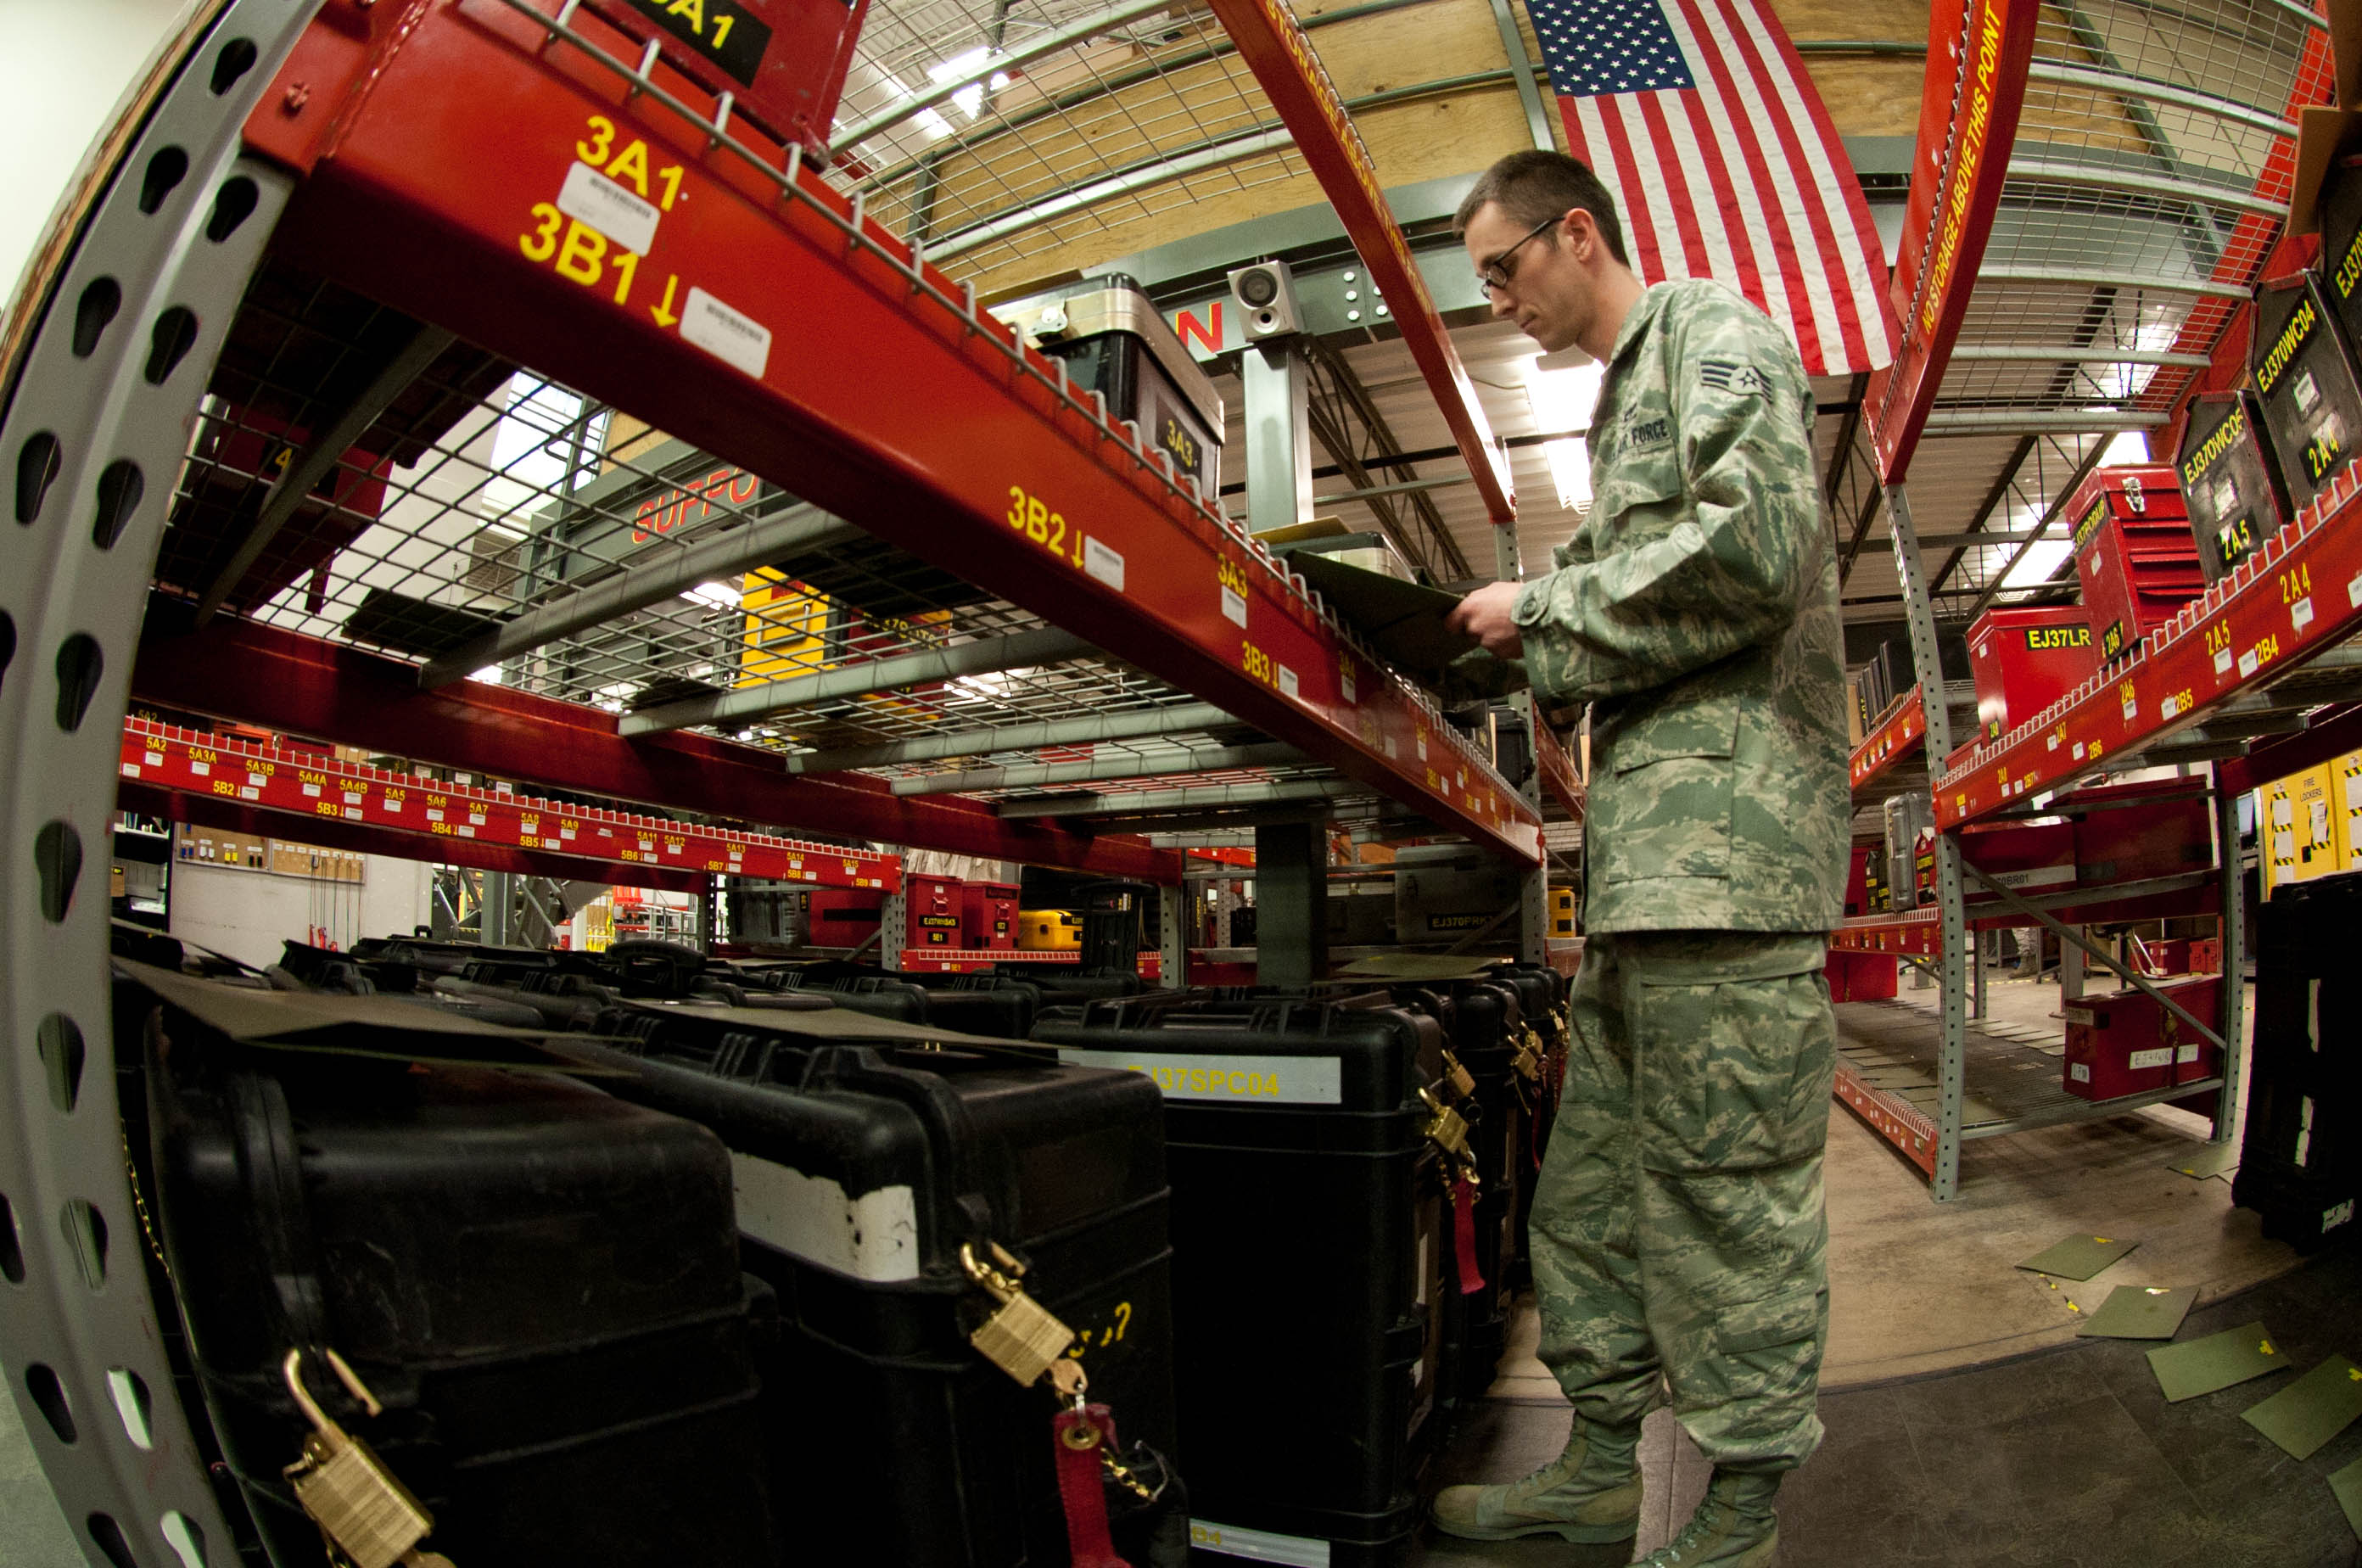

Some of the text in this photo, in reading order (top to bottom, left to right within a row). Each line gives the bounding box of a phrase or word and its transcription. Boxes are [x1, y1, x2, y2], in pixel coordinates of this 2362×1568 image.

[652, 0, 735, 49] A1
[577, 115, 684, 210] 3A1
[1922, 0, 2001, 334] NO STORAGE ABOVE THIS POINT
[520, 203, 639, 305] 3B1
[2258, 300, 2314, 391] EJ370WC04
[1632, 418, 1668, 448] FORCE
[1167, 421, 1193, 467] 3A3
[2309, 433, 2339, 478] 2A4
[1008, 485, 1066, 557] 3B2
[2222, 520, 2249, 560] 2A5
[1217, 553, 1248, 597] 3A3
[2279, 563, 2311, 605] 2A4
[2028, 628, 2091, 648] EJ37LR
[2205, 619, 2230, 657] 2A5
[2254, 633, 2279, 666] 2B4
[1242, 641, 1269, 683] 3B3
[2119, 678, 2135, 705] 2A6
[2174, 687, 2193, 714] 2B5
[2055, 721, 2067, 743] 2A7
[146, 736, 167, 752] 5A2
[2087, 739, 2102, 760] 2B6
[189, 746, 217, 764] 5A3A
[245, 759, 275, 776] 5A3B
[213, 780, 235, 797] 5B2
[299, 770, 327, 787] 5A4A
[339, 778, 368, 795] 5A4B
[385, 787, 406, 802] 5A5
[427, 793, 447, 808] 5A6
[316, 801, 338, 816] 5B3
[469, 801, 490, 815] 5A7
[432, 821, 452, 836] 5B4
[521, 812, 540, 827] 5A8
[561, 818, 579, 832] 5A9
[520, 835, 539, 848] 5B5
[637, 831, 658, 843] 5A11
[664, 834, 686, 848] 5A12
[621, 849, 639, 861] 5B6
[708, 860, 724, 871] 5B7
